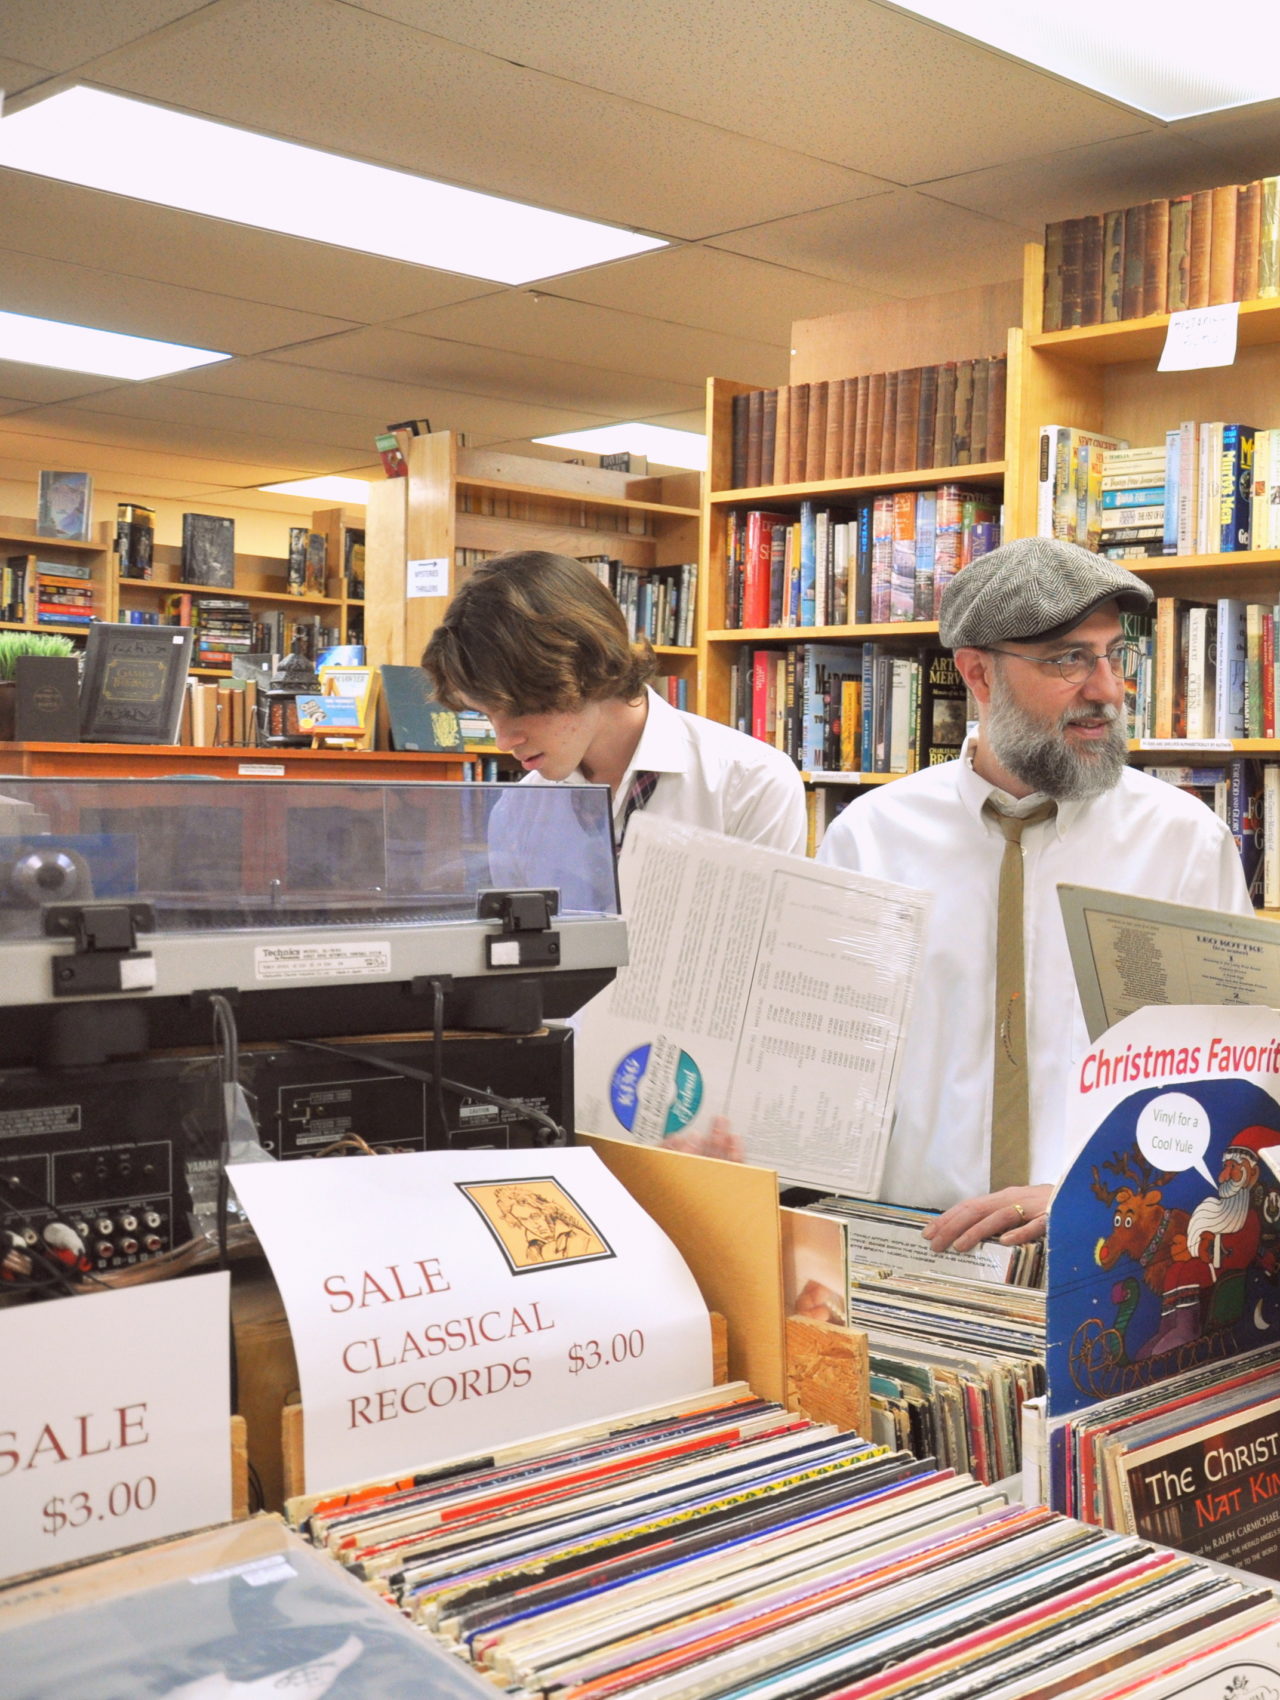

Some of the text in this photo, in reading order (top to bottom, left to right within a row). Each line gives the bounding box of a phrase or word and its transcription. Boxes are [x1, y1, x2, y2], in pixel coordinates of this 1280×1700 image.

[861, 507, 869, 553] WYVERN
[1220, 496, 1235, 525] Men
[862, 655, 874, 711] WHITE HOUSES
[1231, 763, 1241, 778] FOR
[1231, 779, 1242, 797] GOD
[1231, 808, 1242, 832] GLORY
[262, 948, 301, 958] Technics
[1196, 935, 1217, 945] LEO
[1219, 939, 1264, 954] KOTTKE
[1079, 1044, 1202, 1093] Christmas
[1153, 1108, 1177, 1125] Vinyl
[1178, 1112, 1191, 1126] for
[1151, 1136, 1195, 1154] Cool Yule
[323, 1258, 451, 1314] SALE
[341, 1302, 555, 1375] CLASSICAL
[347, 1328, 645, 1429] RECORDS $3.00
[0, 1402, 150, 1477] SALE
[42, 1475, 157, 1537] $3.00
[1194, 1487, 1243, 1528] NAT
[1212, 1532, 1236, 1553] RALPH
[1237, 1510, 1280, 1542] CARMICHAEL
